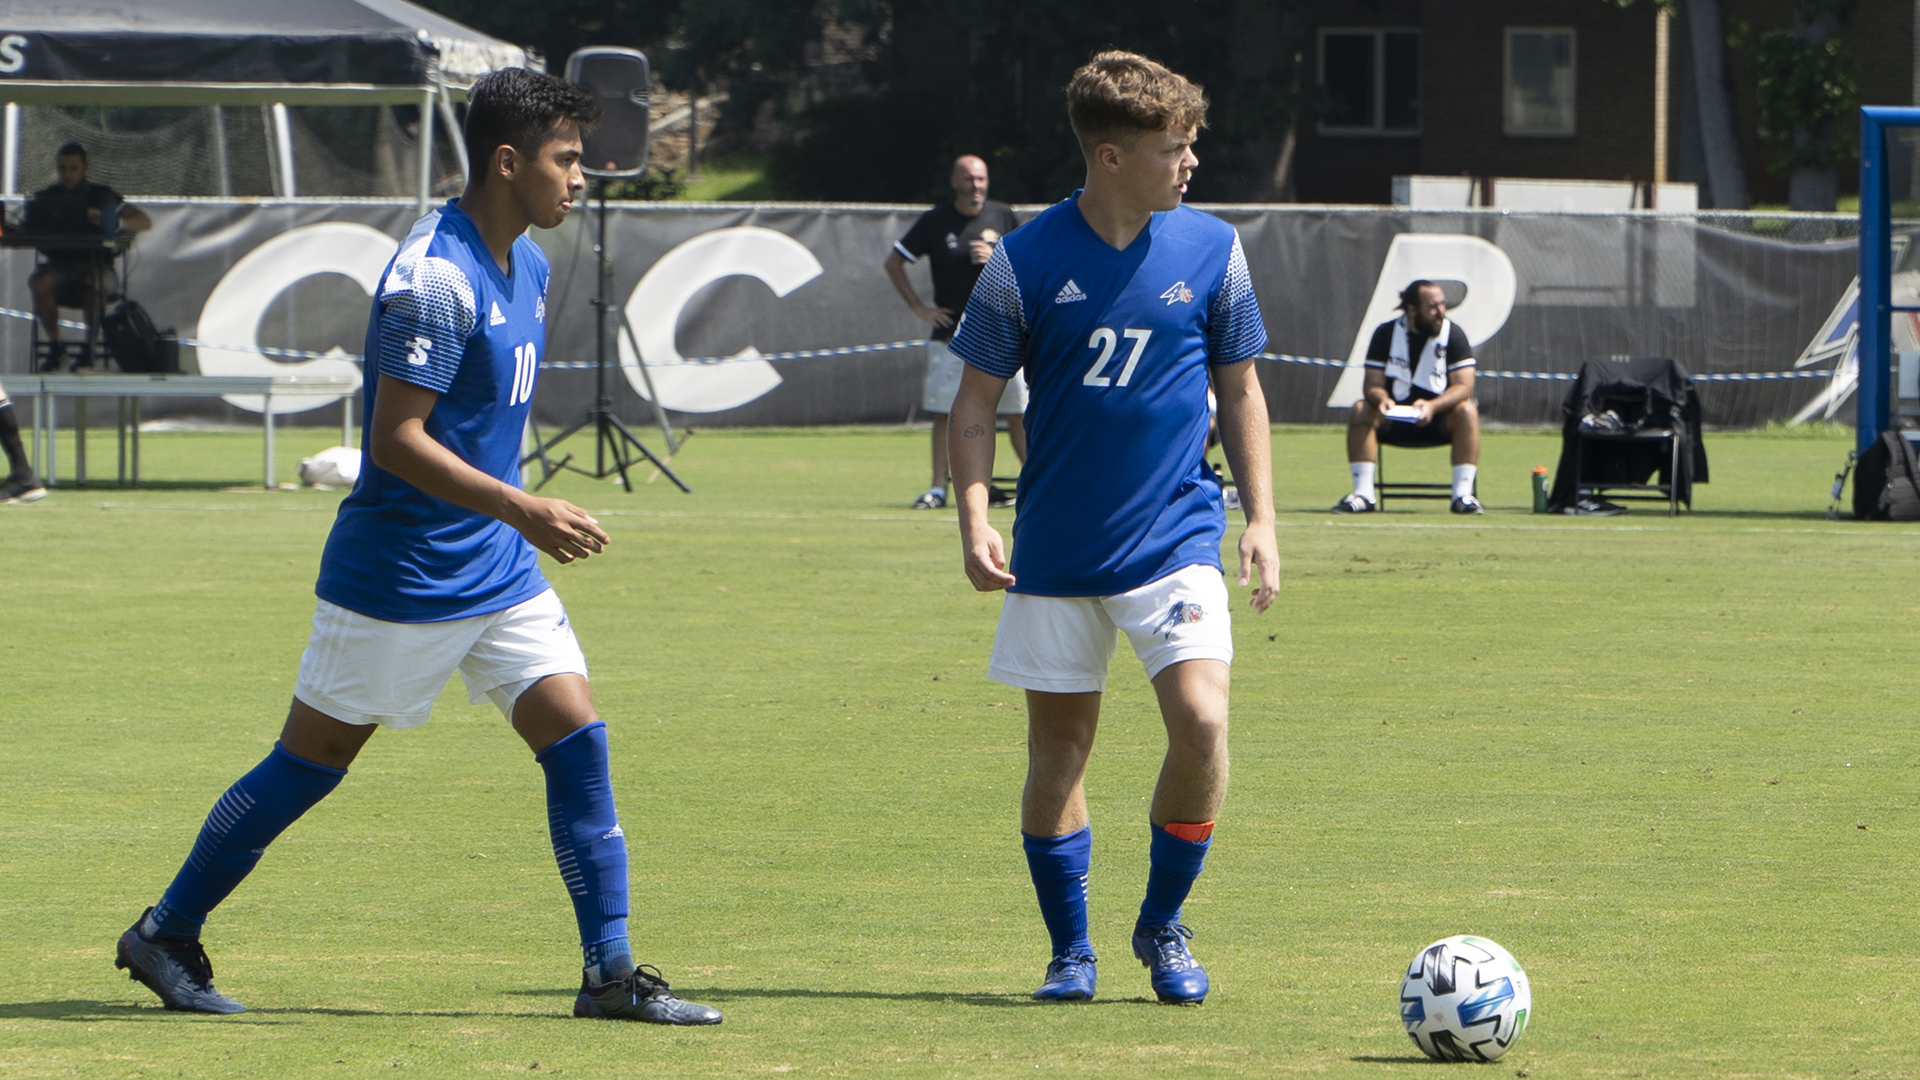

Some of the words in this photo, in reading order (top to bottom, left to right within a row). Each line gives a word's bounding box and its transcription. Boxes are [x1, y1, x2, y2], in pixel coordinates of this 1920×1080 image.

[619, 226, 824, 413] C
[1055, 291, 1087, 304] adidas
[509, 342, 536, 407] 10
[1083, 327, 1153, 387] 27
